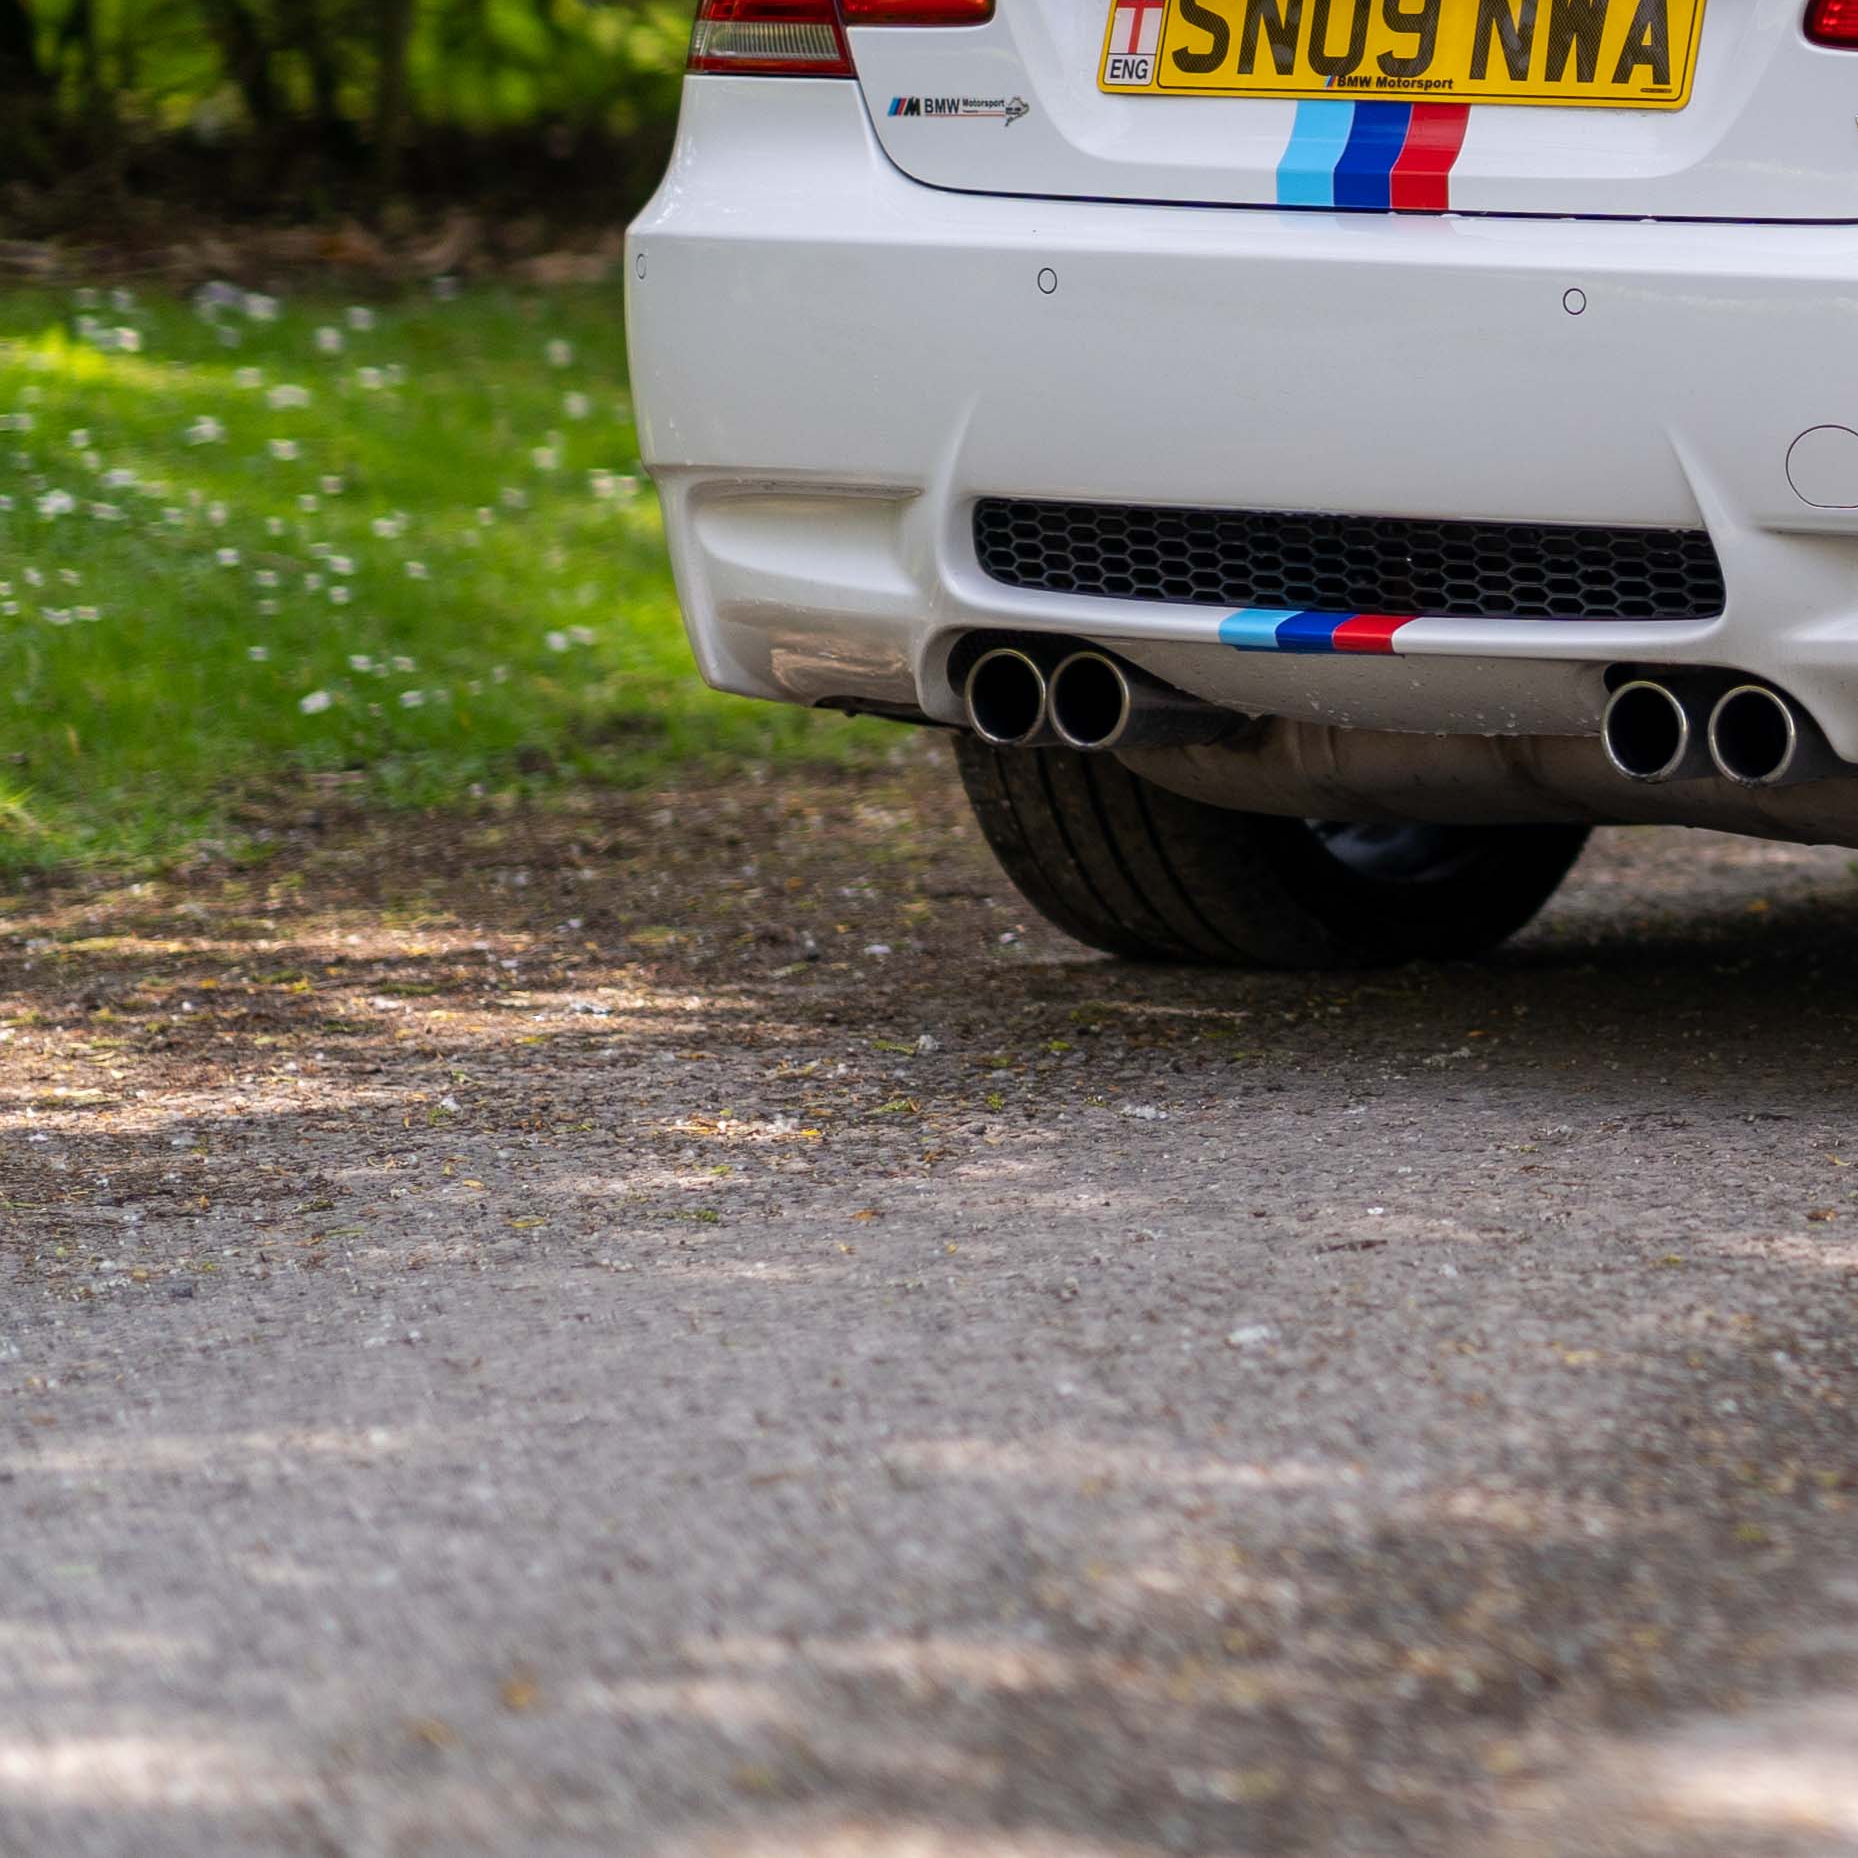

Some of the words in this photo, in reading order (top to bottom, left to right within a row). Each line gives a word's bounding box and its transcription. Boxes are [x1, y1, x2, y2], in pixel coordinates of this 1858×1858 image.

[1109, 59, 1149, 80] ENG
[1337, 75, 1372, 88] BMW
[1376, 76, 1454, 90] Motorsport
[924, 98, 960, 114] BMW
[962, 98, 1005, 109] Motorsport
